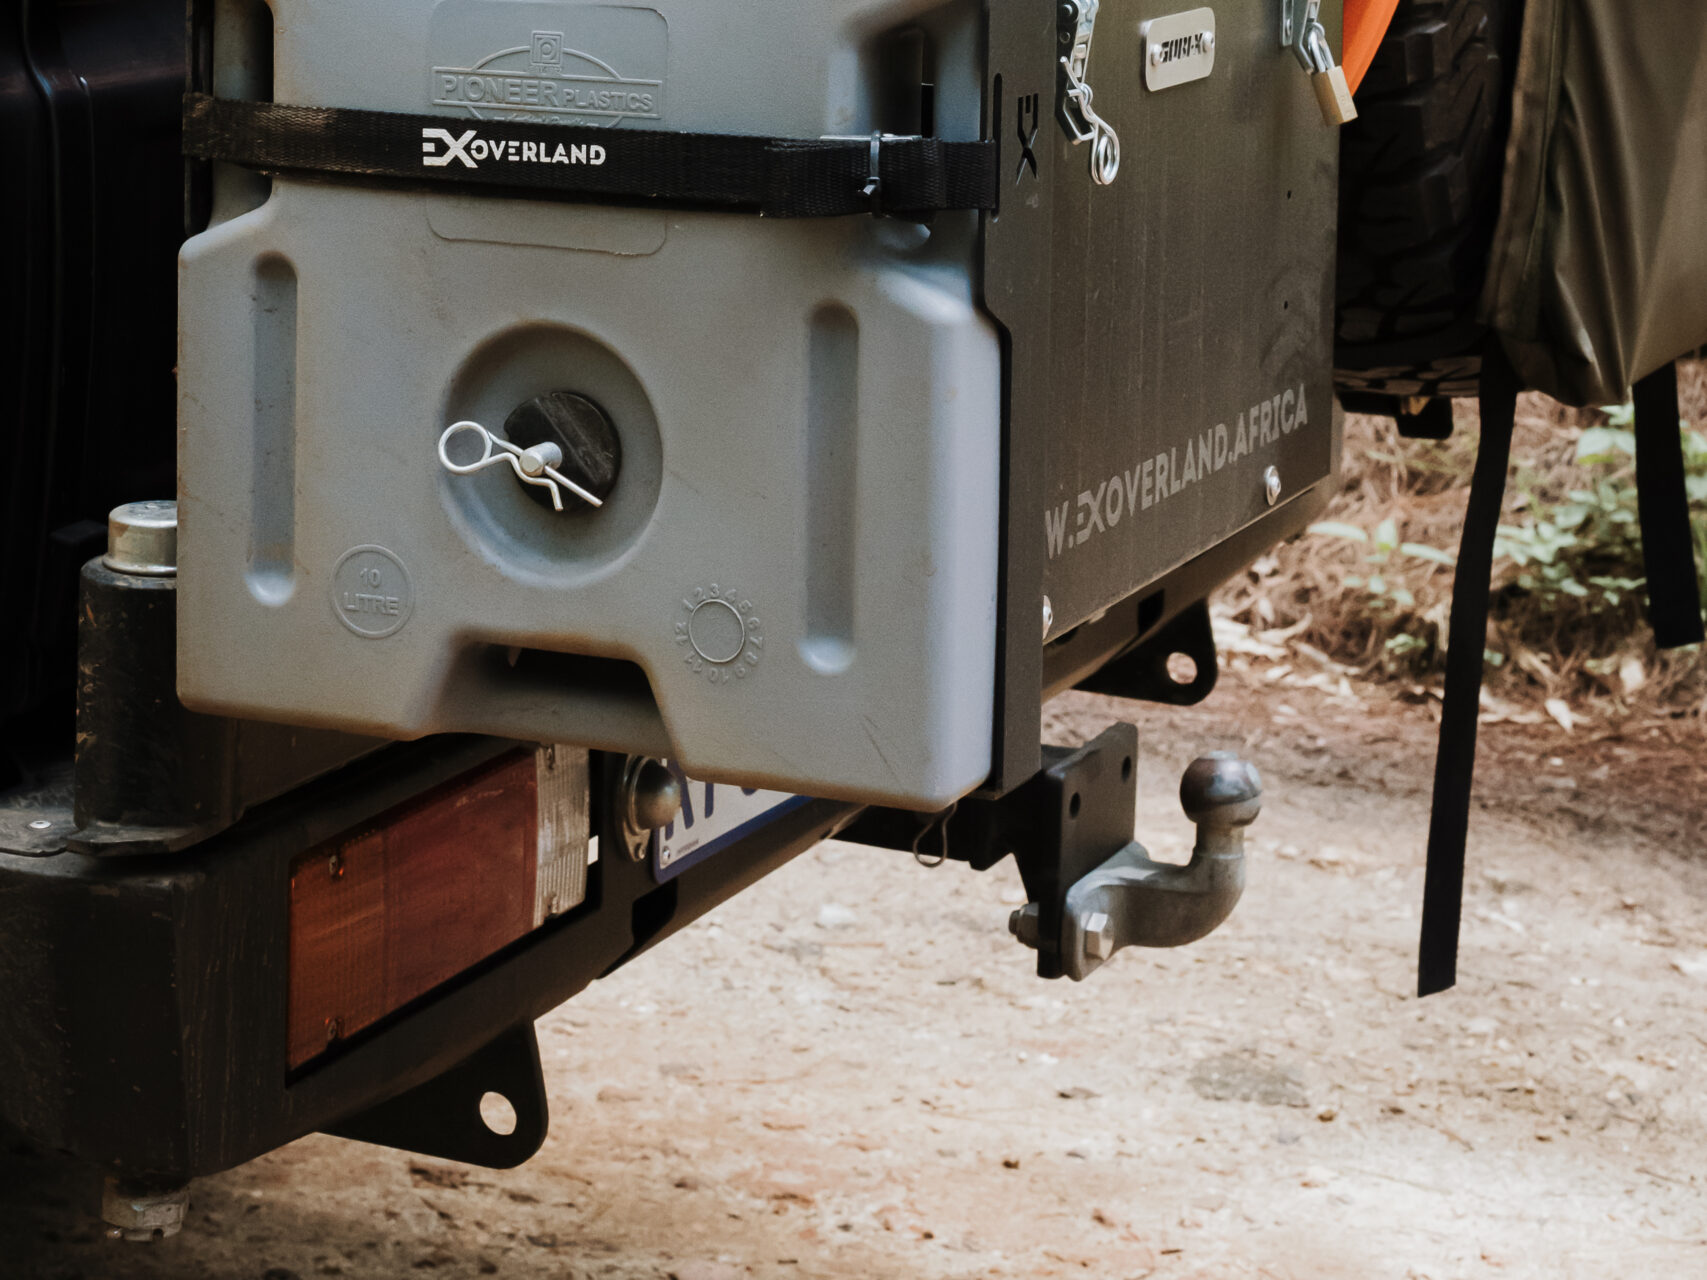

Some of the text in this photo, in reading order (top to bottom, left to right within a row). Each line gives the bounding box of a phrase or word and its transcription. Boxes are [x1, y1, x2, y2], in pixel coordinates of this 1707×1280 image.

[440, 74, 653, 112] PIONEER PLASTICS
[422, 128, 606, 168] EXOVERLAND
[360, 567, 381, 587] 10
[343, 592, 399, 616] LITRE
